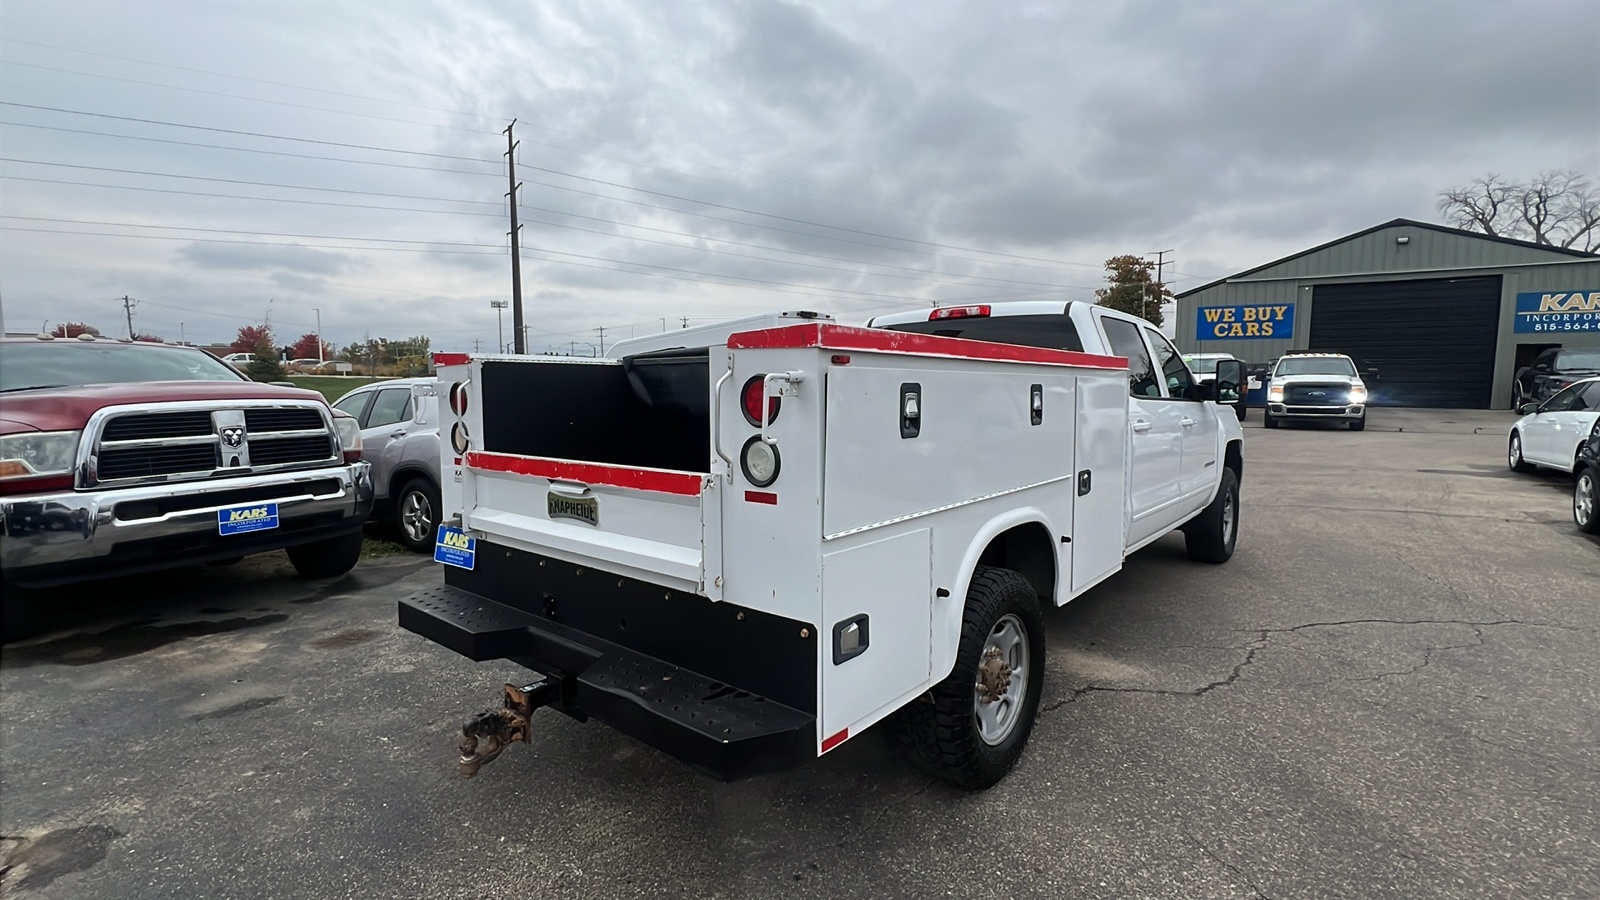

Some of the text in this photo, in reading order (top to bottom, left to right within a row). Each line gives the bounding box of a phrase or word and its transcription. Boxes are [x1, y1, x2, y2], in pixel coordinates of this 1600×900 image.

[1204, 306, 1288, 322] WE BUY
[1214, 322, 1274, 337] CARS
[230, 507, 268, 521] KARS
[549, 499, 595, 522] KNAPHEIDE
[444, 531, 470, 549] KARS
